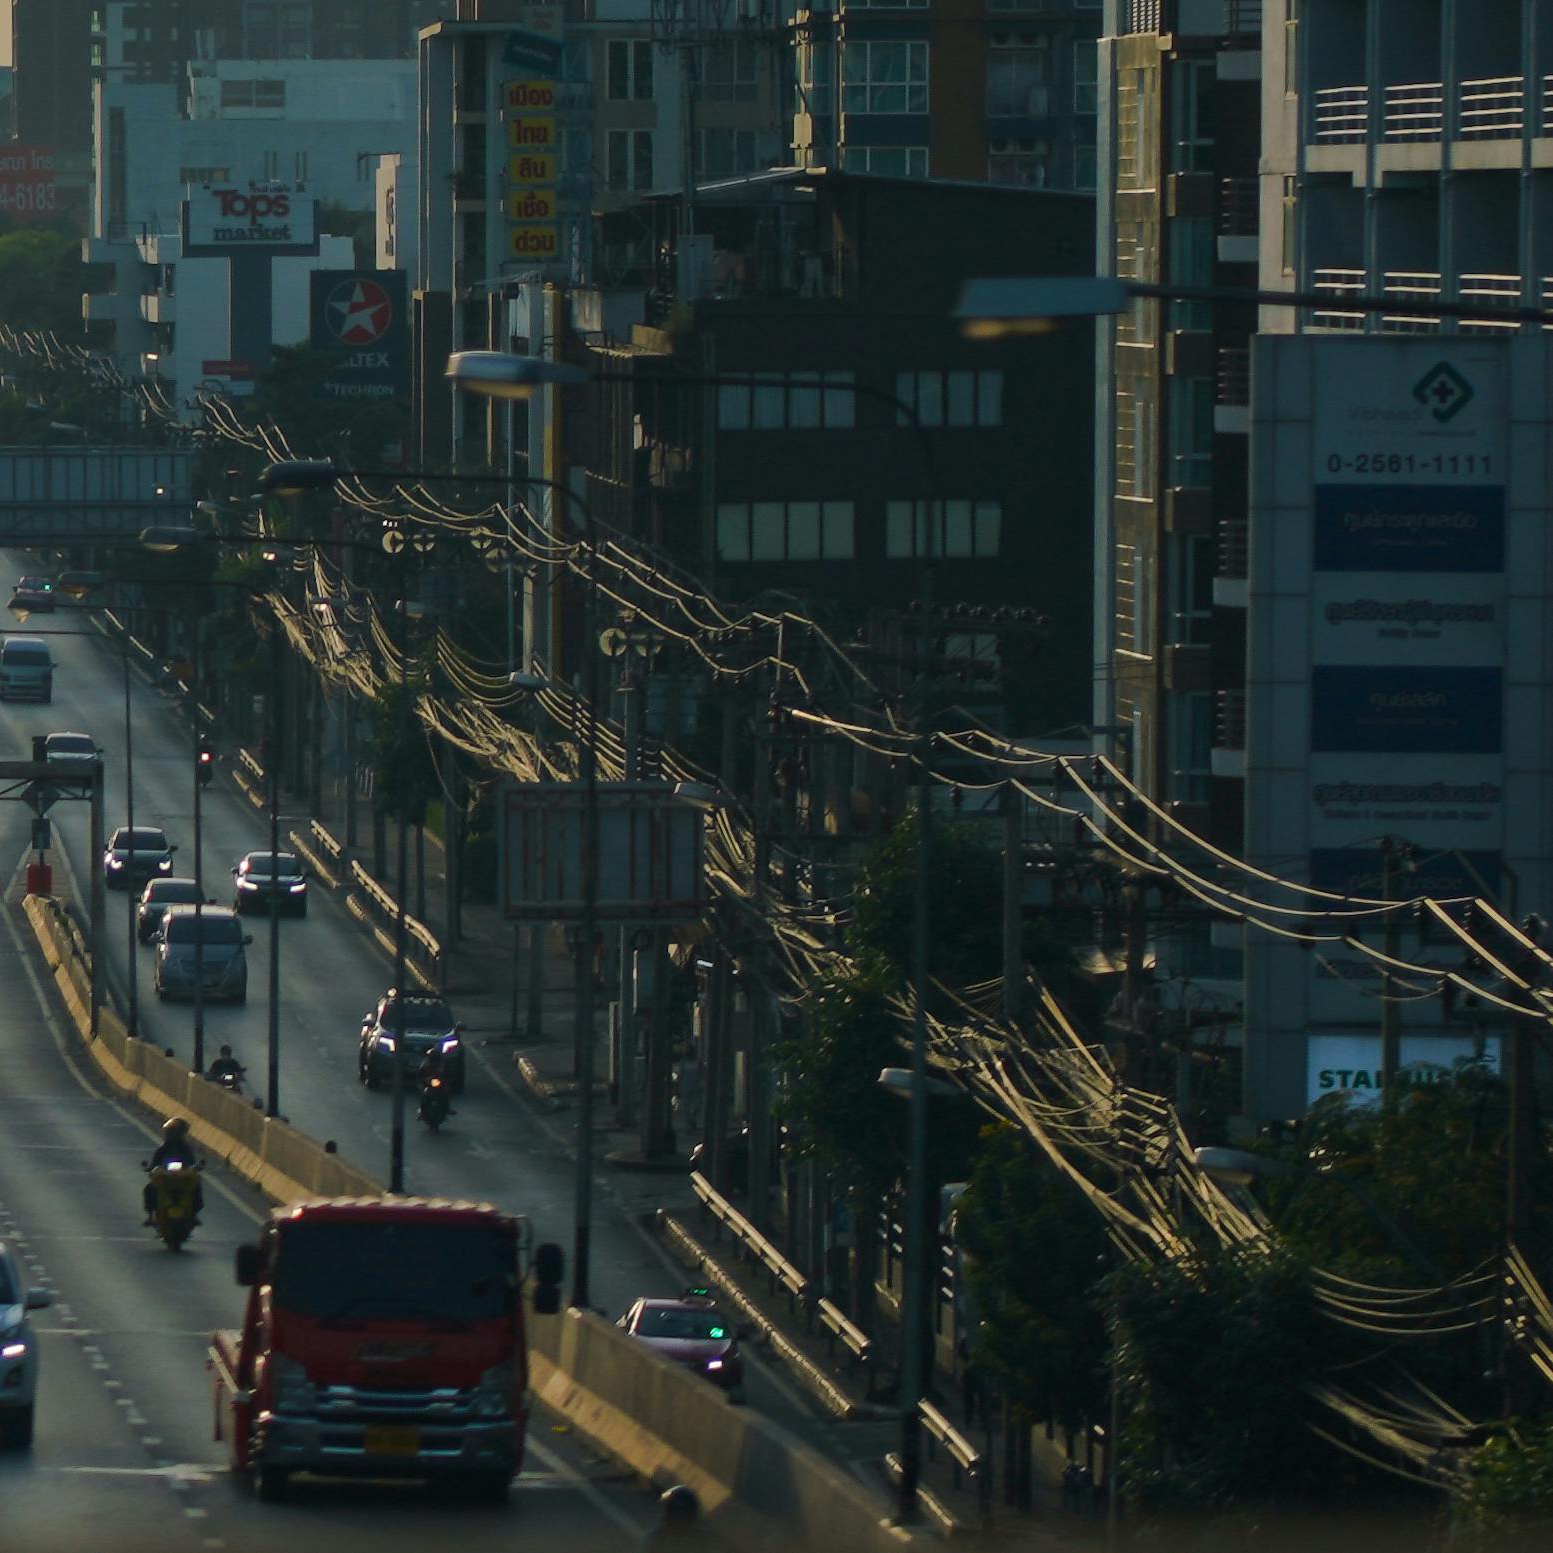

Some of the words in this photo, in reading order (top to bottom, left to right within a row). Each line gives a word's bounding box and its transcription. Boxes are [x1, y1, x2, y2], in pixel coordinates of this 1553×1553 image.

[515, 119, 548, 144] ไทย
[212, 189, 290, 225] Tops
[213, 223, 292, 241] market
[335, 351, 391, 368] LTEX
[1327, 453, 1492, 474] 0-2561-1111
